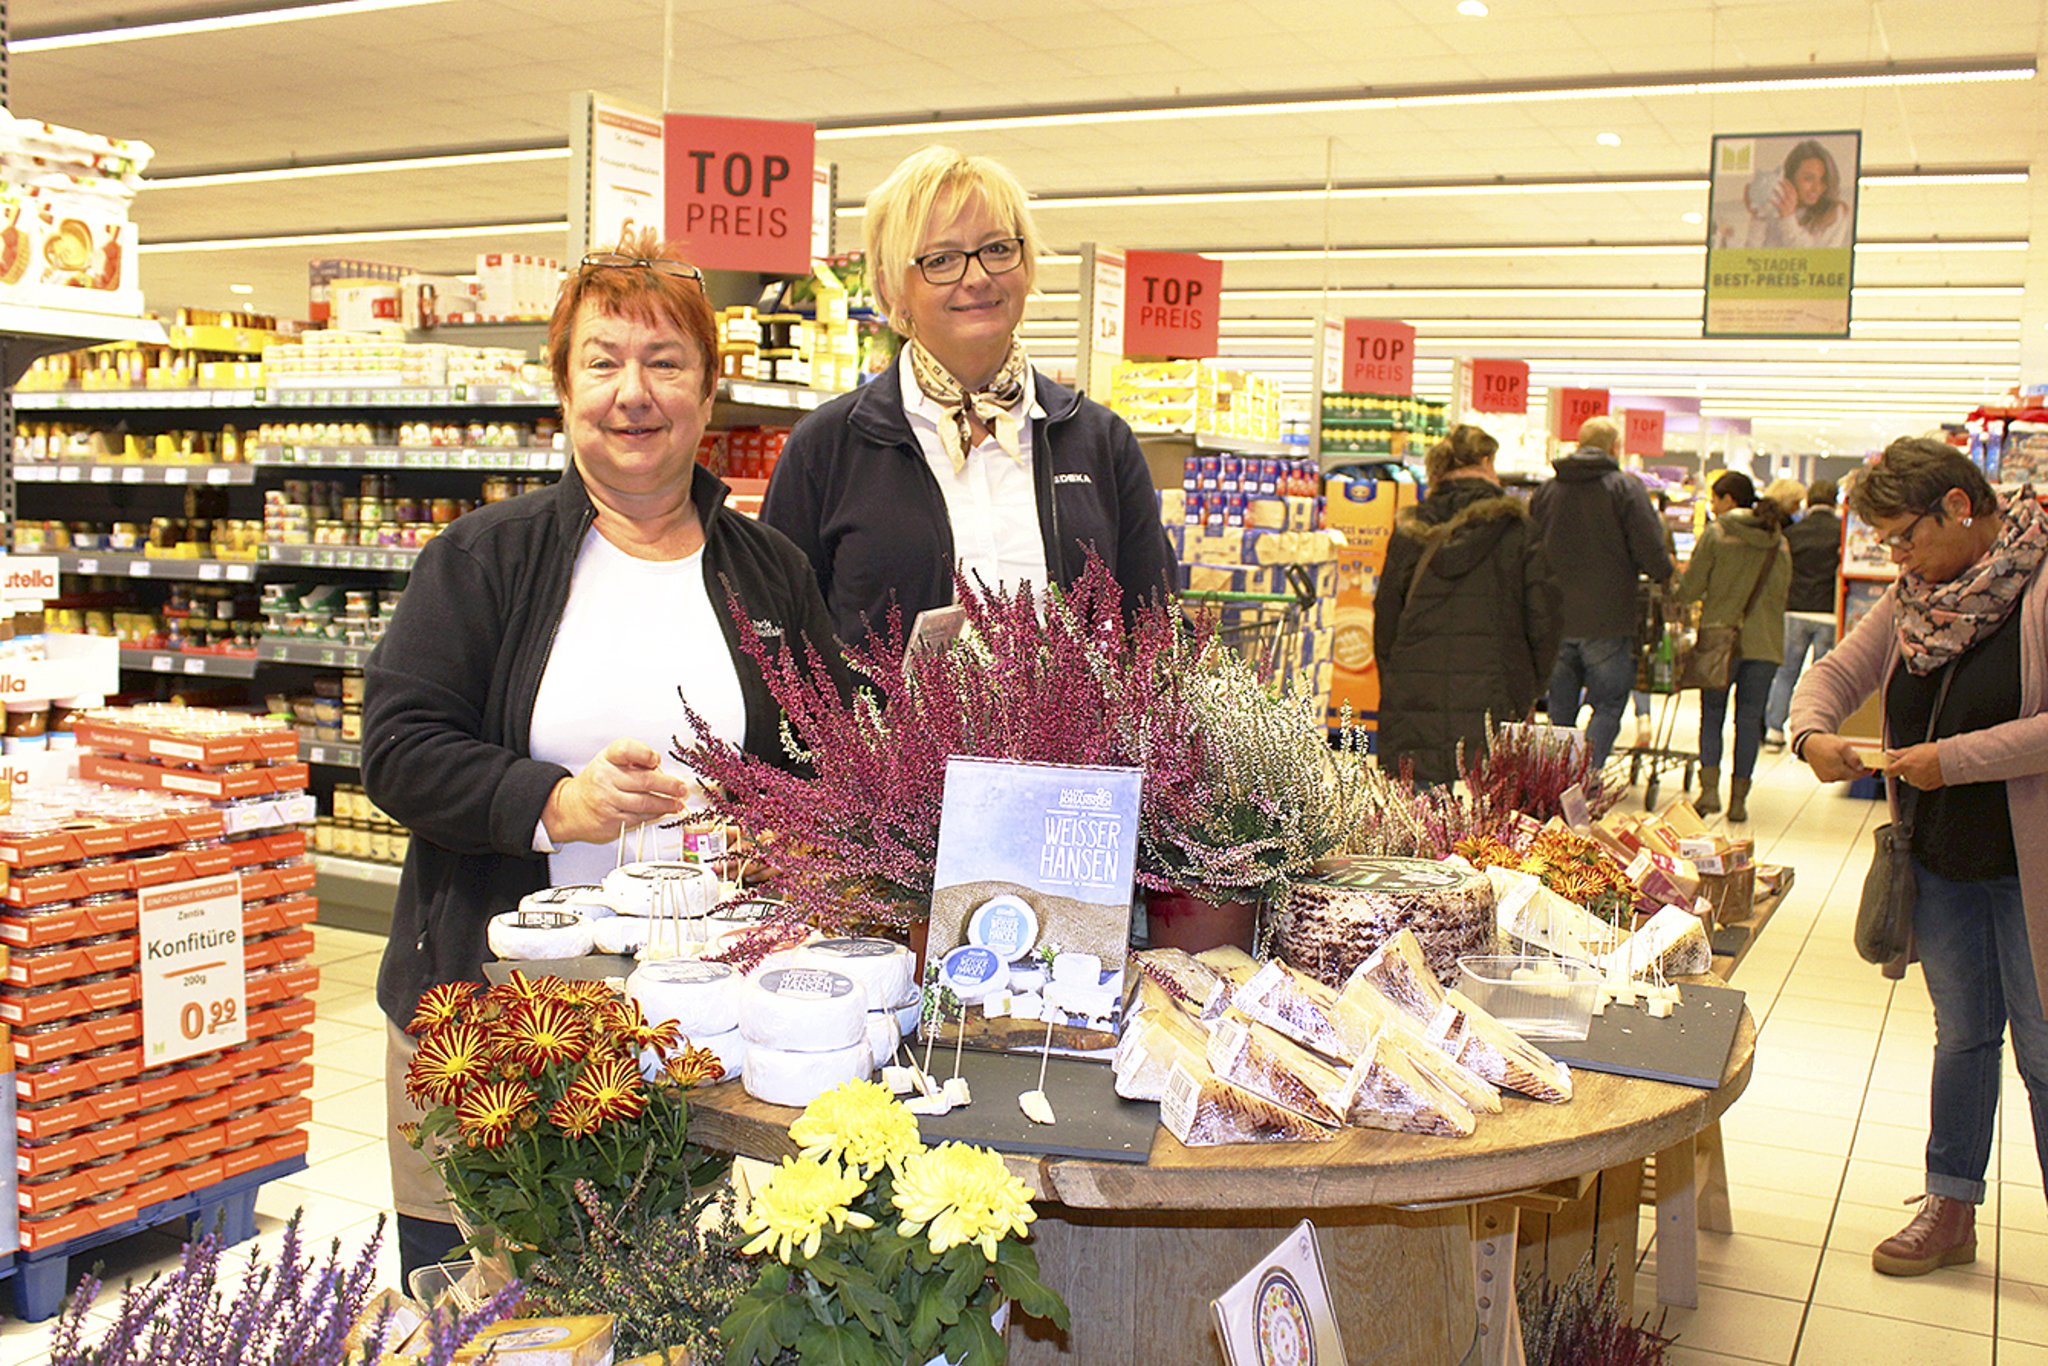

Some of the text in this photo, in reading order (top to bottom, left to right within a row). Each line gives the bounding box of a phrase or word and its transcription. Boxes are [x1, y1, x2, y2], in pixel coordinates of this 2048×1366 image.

[688, 150, 790, 198] TOP
[686, 203, 788, 238] PREIS
[1713, 272, 1846, 287] BEST-PREIS-TAGE
[1143, 276, 1203, 305] TOP
[1140, 306, 1203, 329] PREIS
[1356, 336, 1404, 361] TOP
[1354, 362, 1404, 382] PREIS
[1484, 374, 1520, 392] TOP
[1571, 399, 1602, 415] TOP
[1632, 418, 1658, 432] TOP
[4, 569, 54, 588] utella
[1044, 816, 1122, 850] WEISSER
[1040, 844, 1119, 882] HANSEN
[177, 909, 205, 921] Zentis
[147, 929, 237, 960] Konfitüre
[183, 974, 207, 987] 200g
